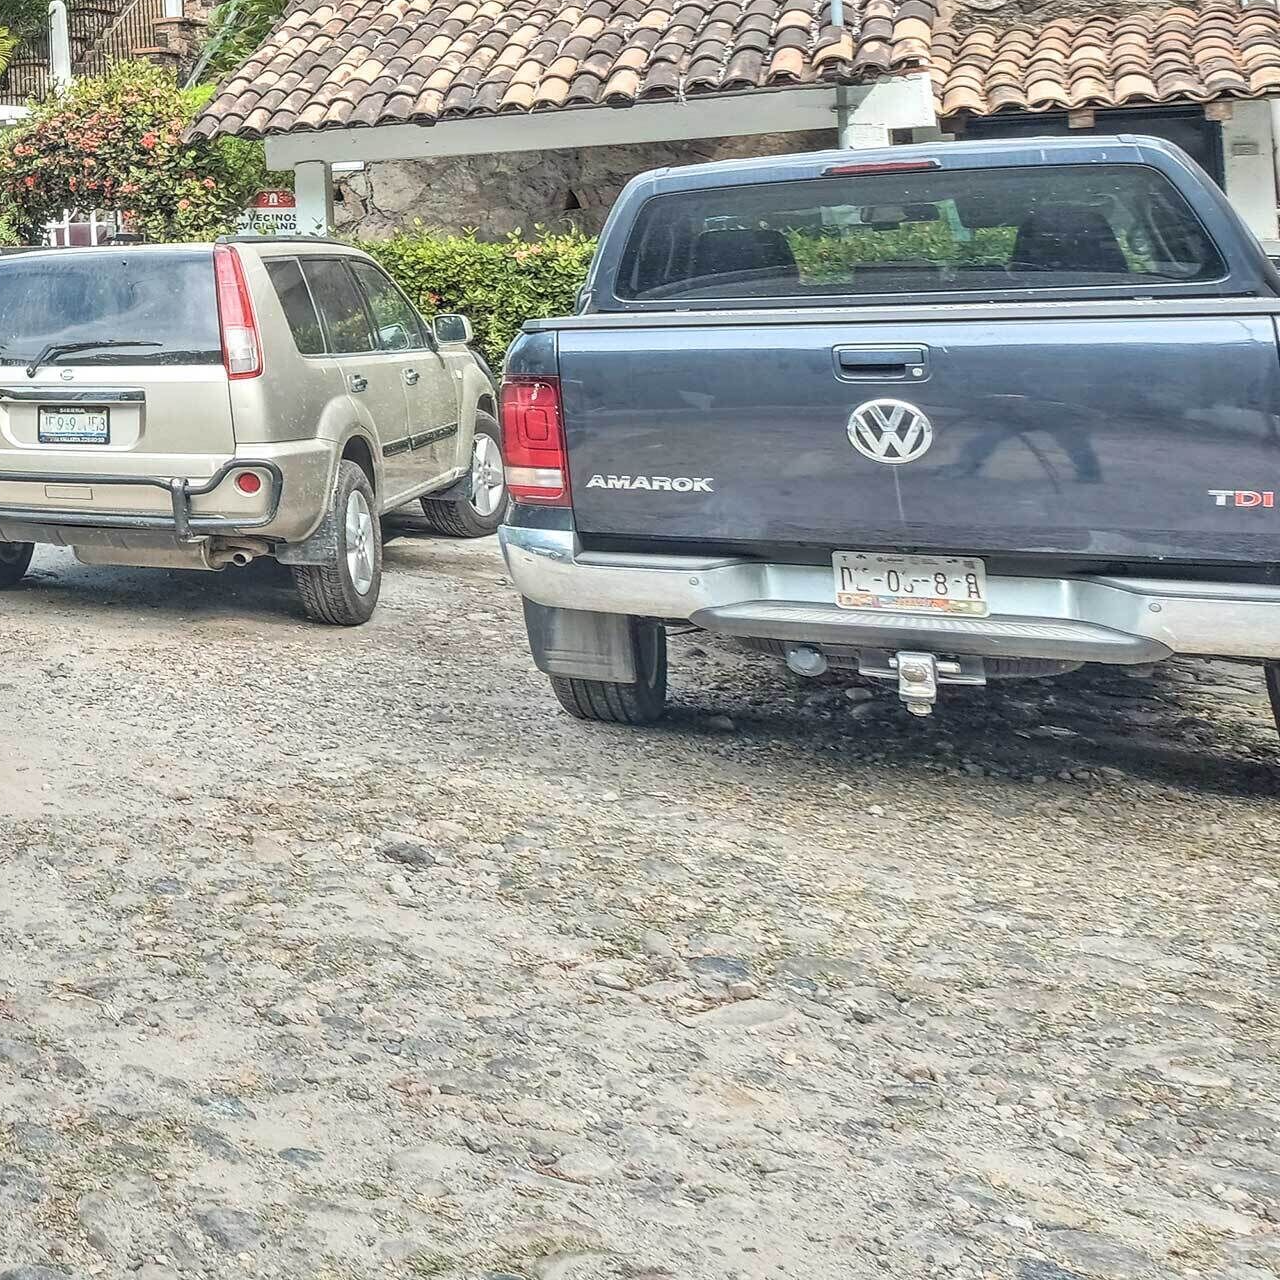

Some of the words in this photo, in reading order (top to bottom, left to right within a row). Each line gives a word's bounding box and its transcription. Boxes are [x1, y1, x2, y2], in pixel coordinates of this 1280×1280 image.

[248, 213, 296, 222] VECINOS
[241, 222, 296, 230] VIGILAND
[585, 474, 714, 492] AMAROK
[1207, 489, 1274, 508] TDI
